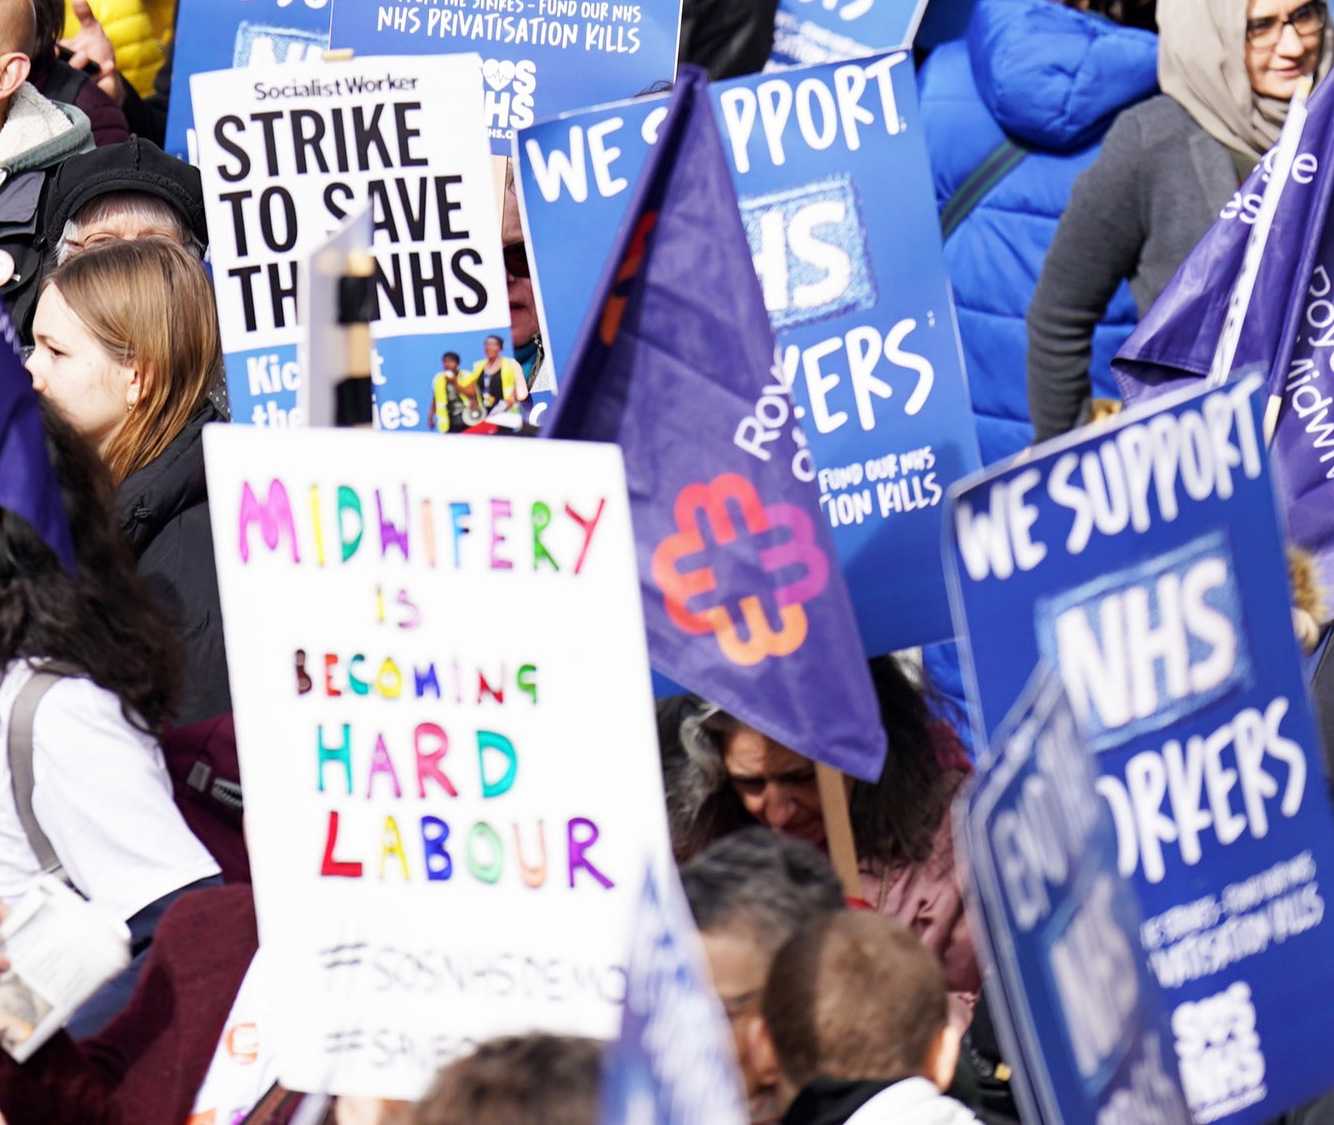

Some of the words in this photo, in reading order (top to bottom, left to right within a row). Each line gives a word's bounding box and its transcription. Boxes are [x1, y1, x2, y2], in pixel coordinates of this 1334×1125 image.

[377, 5, 421, 35] NHS
[427, 7, 580, 50] PRIVATISATION
[585, 25, 641, 55] KILLS
[580, 1, 610, 21] OUR
[612, 4, 642, 24] NHS
[254, 78, 343, 101] Socialist
[345, 73, 420, 97] Worker
[214, 102, 430, 183] STRIKE
[525, 116, 629, 204] WE
[219, 186, 299, 258] TO
[818, 467, 865, 494] FUND
[864, 452, 900, 482] OUR
[899, 445, 936, 476] NHS
[876, 472, 944, 519] KILLS
[953, 467, 1049, 582] WE
[1047, 372, 1264, 555] SUPPORT
[238, 478, 607, 575] MIDWIFERY
[375, 584, 421, 630] IS
[1056, 556, 1237, 729] NHS
[294, 649, 539, 706] BECOMING
[317, 721, 520, 800] HARD
[320, 810, 615, 891] LABOUR
